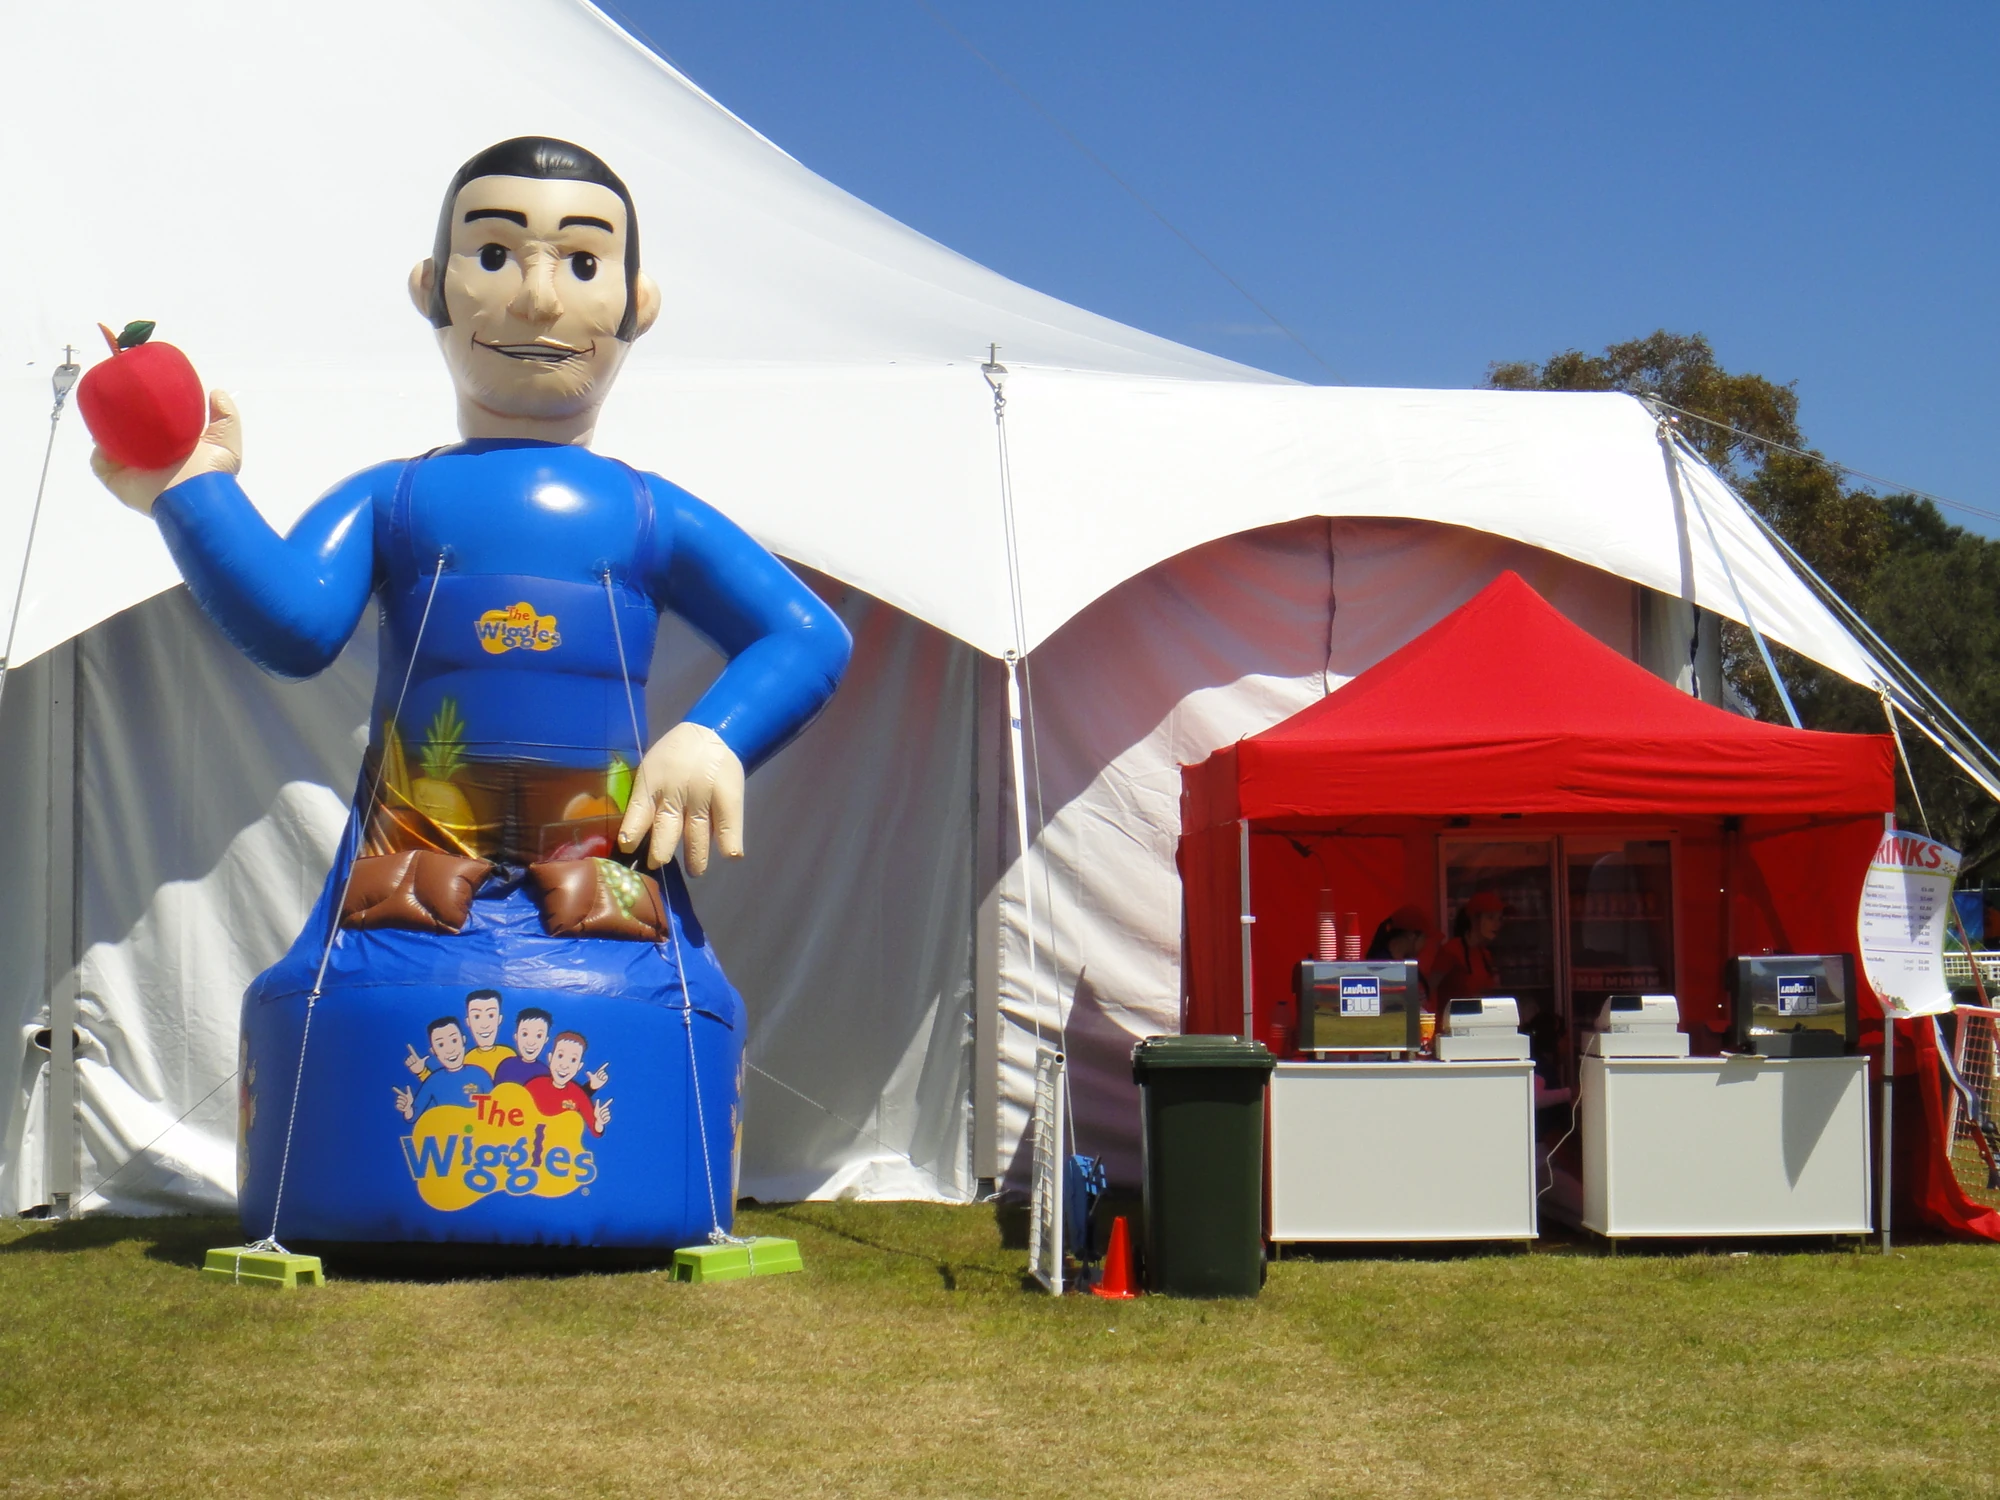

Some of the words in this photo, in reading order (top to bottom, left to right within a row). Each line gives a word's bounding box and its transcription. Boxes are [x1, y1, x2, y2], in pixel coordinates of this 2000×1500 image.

[506, 606, 530, 621] The
[474, 620, 562, 649] Wiggles
[1343, 984, 1377, 994] LAVAZZA
[1780, 983, 1814, 993] LAVAZZA
[1347, 999, 1378, 1012] BLUE
[472, 1095, 525, 1127] The
[401, 1124, 597, 1195] Wiggles
